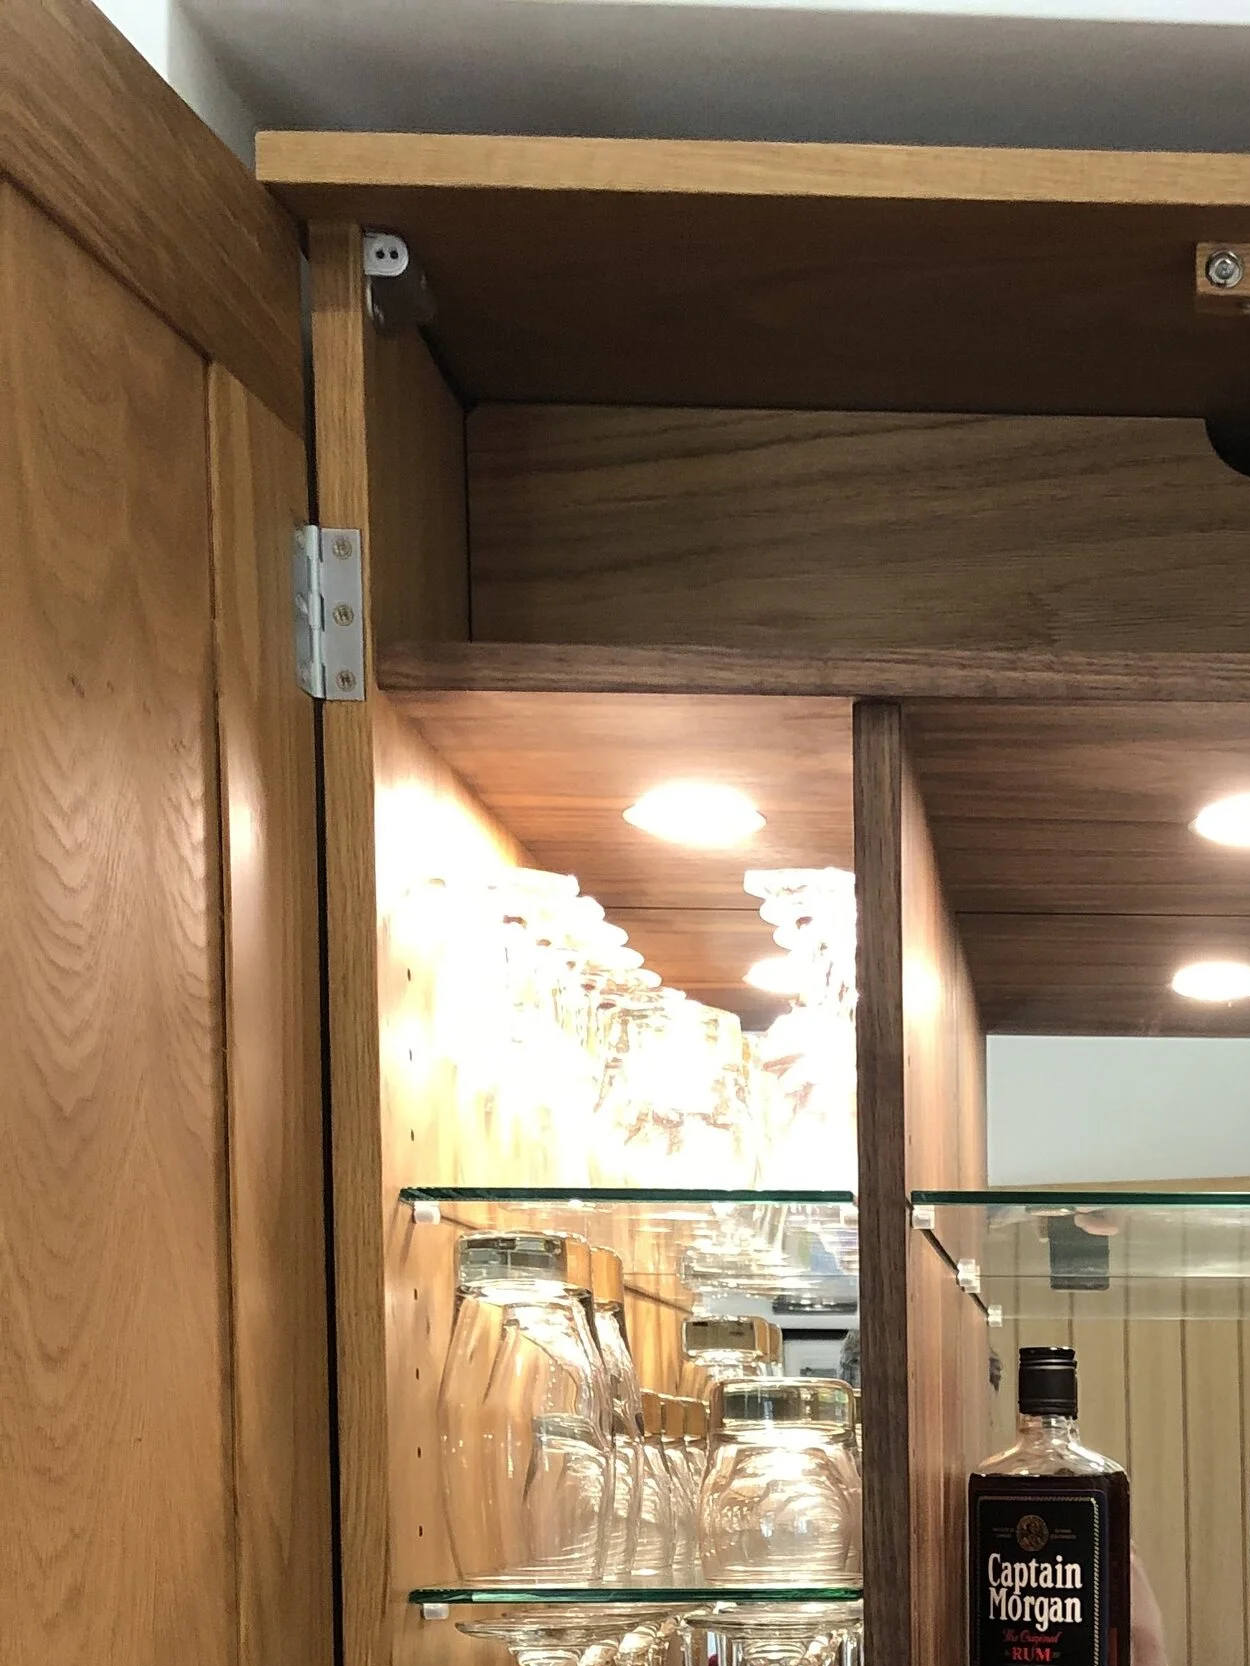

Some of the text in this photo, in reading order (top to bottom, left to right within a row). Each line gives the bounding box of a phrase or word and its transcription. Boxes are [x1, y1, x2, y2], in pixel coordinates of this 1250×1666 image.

[987, 1552, 1083, 1595] Captain
[988, 1587, 1083, 1632] Morgan
[1010, 1646, 1052, 1662] RUM
